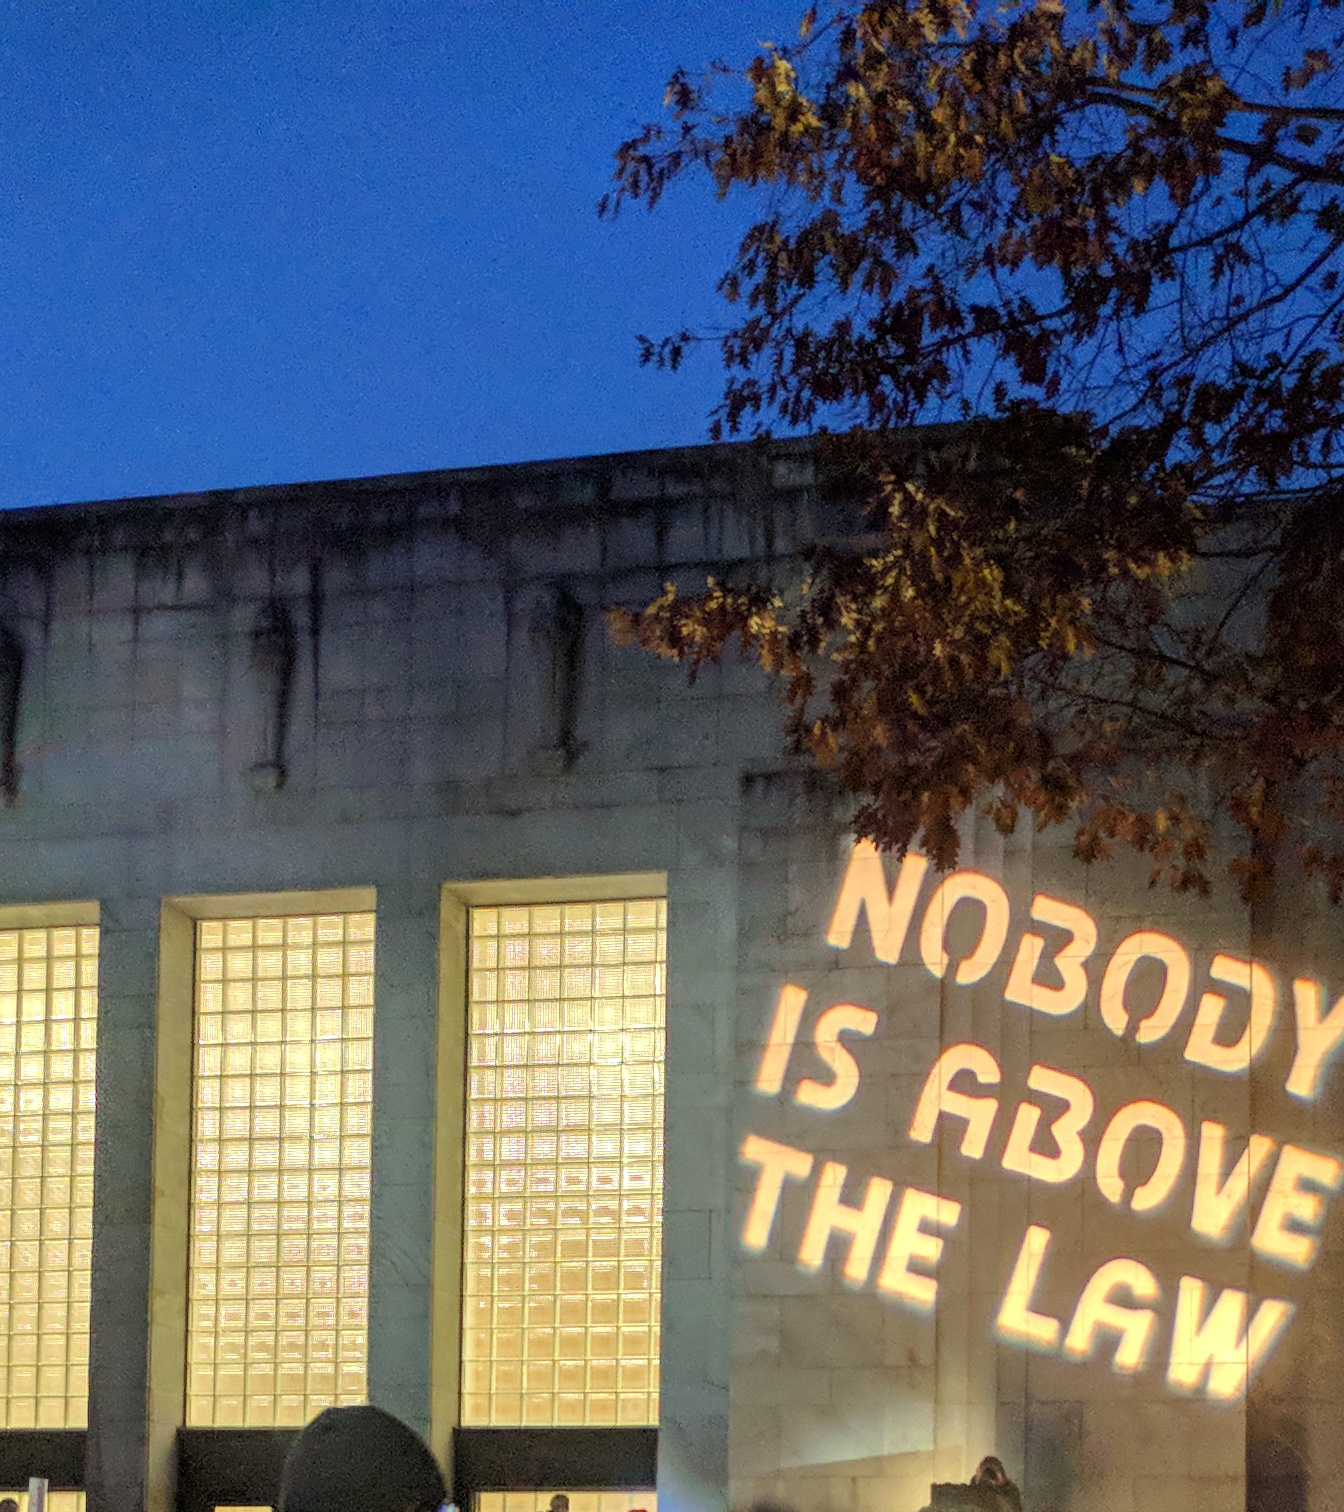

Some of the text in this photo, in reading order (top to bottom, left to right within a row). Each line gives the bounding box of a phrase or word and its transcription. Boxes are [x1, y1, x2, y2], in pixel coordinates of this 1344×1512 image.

[755, 983, 1344, 1270] IS ABOVE
[741, 1133, 1296, 1401] THE LAW
